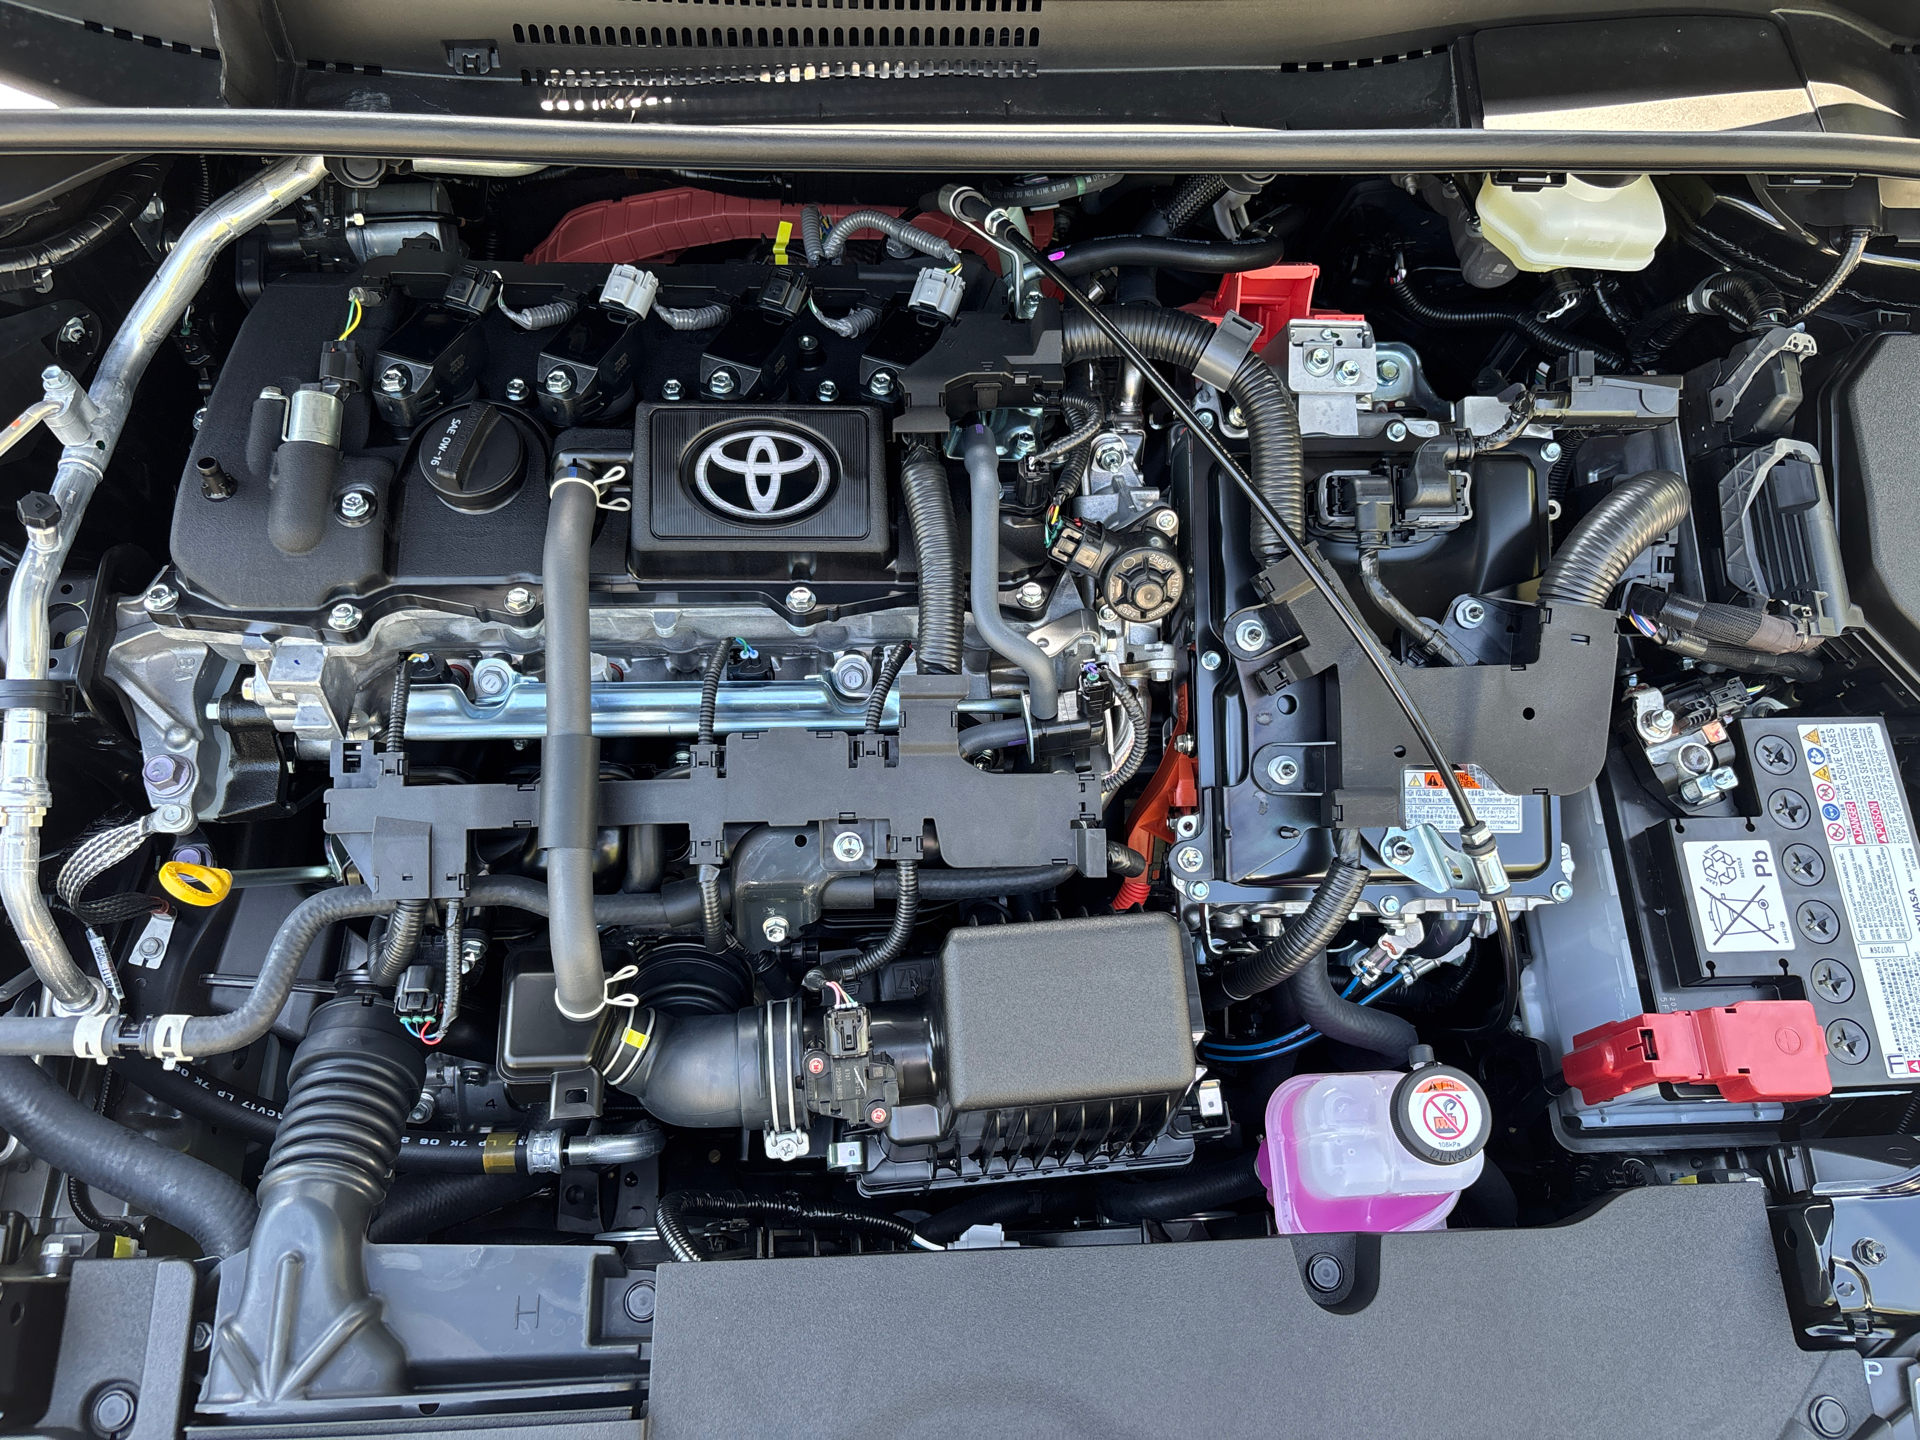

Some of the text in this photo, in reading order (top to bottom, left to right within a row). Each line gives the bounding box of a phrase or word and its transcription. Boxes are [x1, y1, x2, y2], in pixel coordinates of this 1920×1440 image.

[430, 418, 461, 466] SAE 0W-16
[1149, 553, 1171, 569] 25620
[1170, 574, 1180, 597] 37140
[1147, 605, 1171, 619] TOYOTA
[1825, 728, 1840, 754] GASES
[1848, 727, 1862, 748] BURNS
[1854, 750, 1869, 773] SEVERE
[1833, 757, 1853, 800] EXPLOSIVE
[1861, 775, 1876, 799] CAUSES
[1878, 748, 1910, 843] KEEP VENT CAPS TIGHT AND LEVEL
[1883, 791, 1891, 800] OUT
[1845, 803, 1862, 834] DANGER
[1869, 802, 1885, 833] POISON
[1893, 825, 1901, 835] NOT
[1752, 850, 1773, 877] Pb
[194, 1076, 210, 1090] 7K
[217, 1090, 235, 1102] LP
[419, 1138, 440, 1146] 06
[1430, 1146, 1473, 1162] DENSO
[515, 1294, 541, 1330] H
[1863, 1361, 1883, 1384] P
